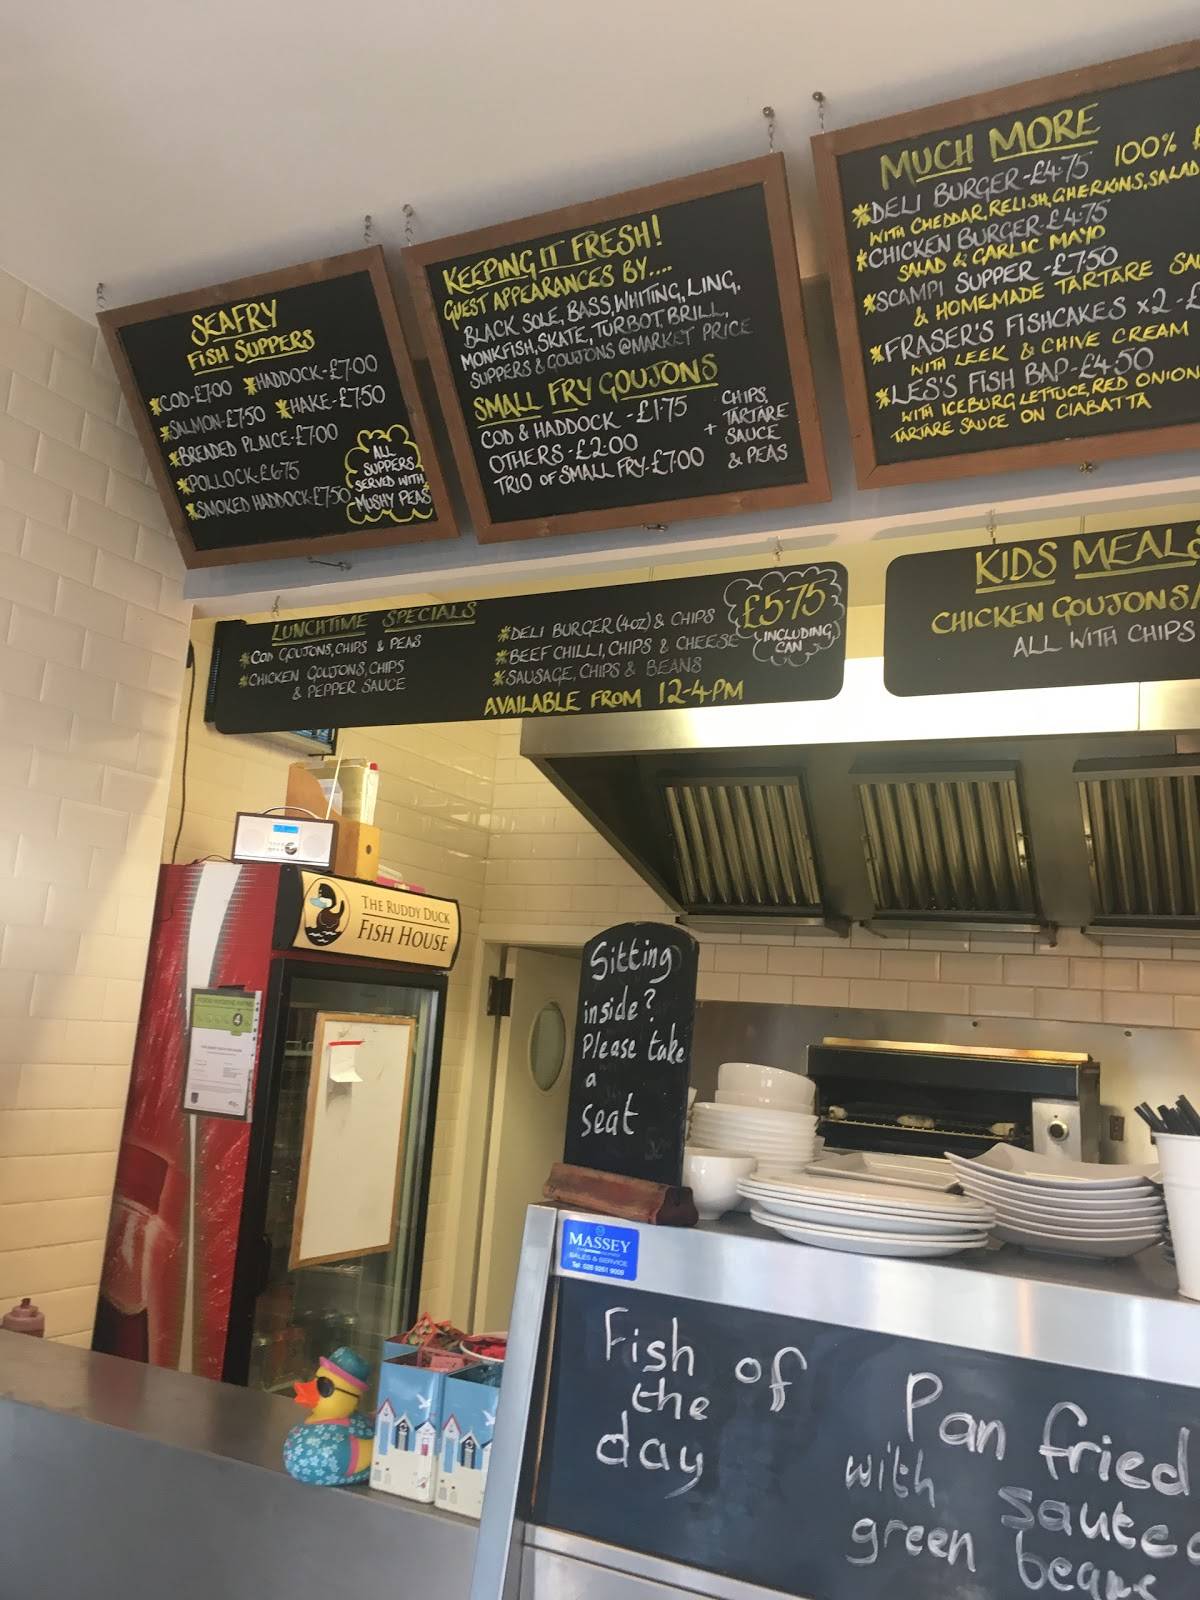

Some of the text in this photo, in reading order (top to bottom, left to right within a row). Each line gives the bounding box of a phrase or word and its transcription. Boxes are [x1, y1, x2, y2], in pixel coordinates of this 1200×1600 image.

[880, 102, 1100, 191] MUCH MORE
[1115, 131, 1177, 167] 100%
[869, 227, 905, 246] WITH
[1149, 160, 1200, 186] SALAD
[871, 194, 921, 225] DELI
[442, 214, 663, 295] KEEPING IT FRESH!
[868, 233, 951, 269] CHICKEN
[897, 225, 1106, 283] SALAD & GARLIC MAYO
[443, 296, 488, 331] GUEST
[493, 263, 614, 312] APPEARANCES
[875, 280, 945, 312] SCAMPI
[955, 260, 1041, 294] SUPPER
[913, 308, 929, 327] &
[935, 283, 1046, 322] HOMEMADE
[1054, 259, 1154, 296] TARTARE
[191, 299, 277, 346] SEAFRY
[463, 314, 518, 349] BLACK
[885, 323, 994, 362] FRASER'S
[1006, 296, 1127, 338] FISHCAKES
[187, 329, 315, 371] FISH SUPPERS
[471, 361, 531, 389] SUPPERS
[535, 358, 545, 373] &
[547, 345, 616, 371] GOUJONS
[702, 317, 754, 344] PRICE
[911, 320, 1190, 377] WITH LEEK & CHIVE CREAM
[472, 353, 719, 422] SMALL FRY GOUJONS
[890, 367, 1015, 405] LES'S FISH
[901, 406, 934, 423] WITH
[942, 393, 1017, 417] ICEBURG
[1091, 377, 1128, 395] RED
[1135, 365, 1200, 388] ONION
[481, 431, 515, 449] COD
[519, 427, 529, 441] &
[534, 411, 621, 439] HADDOCK
[722, 402, 790, 425] TARTARE
[890, 392, 1152, 444] TARTARE SAUCE ON CIABATTA
[373, 445, 397, 459] ALL
[725, 423, 782, 445] SAUCE
[178, 440, 237, 467] BREADED
[363, 457, 415, 477] SUPPERS
[489, 444, 564, 474] OTHERS
[727, 444, 788, 469] & PEAS
[355, 473, 425, 492] SERVED WITH
[494, 473, 532, 496] TRIO
[558, 462, 616, 486] SMALL
[195, 497, 250, 519] SMOKED
[355, 489, 432, 512] MUSHY PEAS
[975, 541, 1058, 585] KIDS
[271, 601, 477, 641] LUNCHTIME SPECIALS
[510, 626, 544, 642] DELI
[553, 615, 613, 638] BURGER
[653, 614, 665, 629] &
[670, 608, 716, 627] CHIPS
[763, 623, 833, 643] INCLUDING
[931, 601, 1044, 634] CHICKEN
[335, 640, 368, 655] CHIPS
[376, 640, 384, 652] &
[390, 635, 422, 650] PEAS
[509, 646, 549, 663] BEEF
[608, 639, 652, 656] CHIPS
[660, 638, 667, 653] &
[676, 634, 739, 652] CHEESE
[775, 640, 804, 653] CAN
[1013, 620, 1196, 658] ALL WITH CHIPS
[248, 669, 299, 687] CHICKEN
[369, 660, 405, 675] CHIPS
[579, 662, 621, 680] CHIPS
[624, 662, 637, 678] &
[646, 657, 703, 677] BEANS
[292, 677, 407, 700] & PEPPER SAUCE
[484, 690, 581, 716] AVAILABLE
[590, 688, 642, 709] FROM
[361, 895, 450, 925] THE RUDDY DUCK
[358, 919, 449, 952] FISH HOUSE
[590, 938, 672, 984] Sitting
[584, 985, 657, 1025] inside?
[582, 1022, 685, 1065] Please take
[585, 1072, 596, 1088] a
[569, 1232, 630, 1253] MASSEY
[604, 1306, 808, 1412] Fish of
[632, 1378, 710, 1421] the
[907, 1372, 1190, 1496] Pan fried
[595, 1410, 703, 1500] day
[846, 1442, 936, 1507] with
[846, 1517, 977, 1573] green
